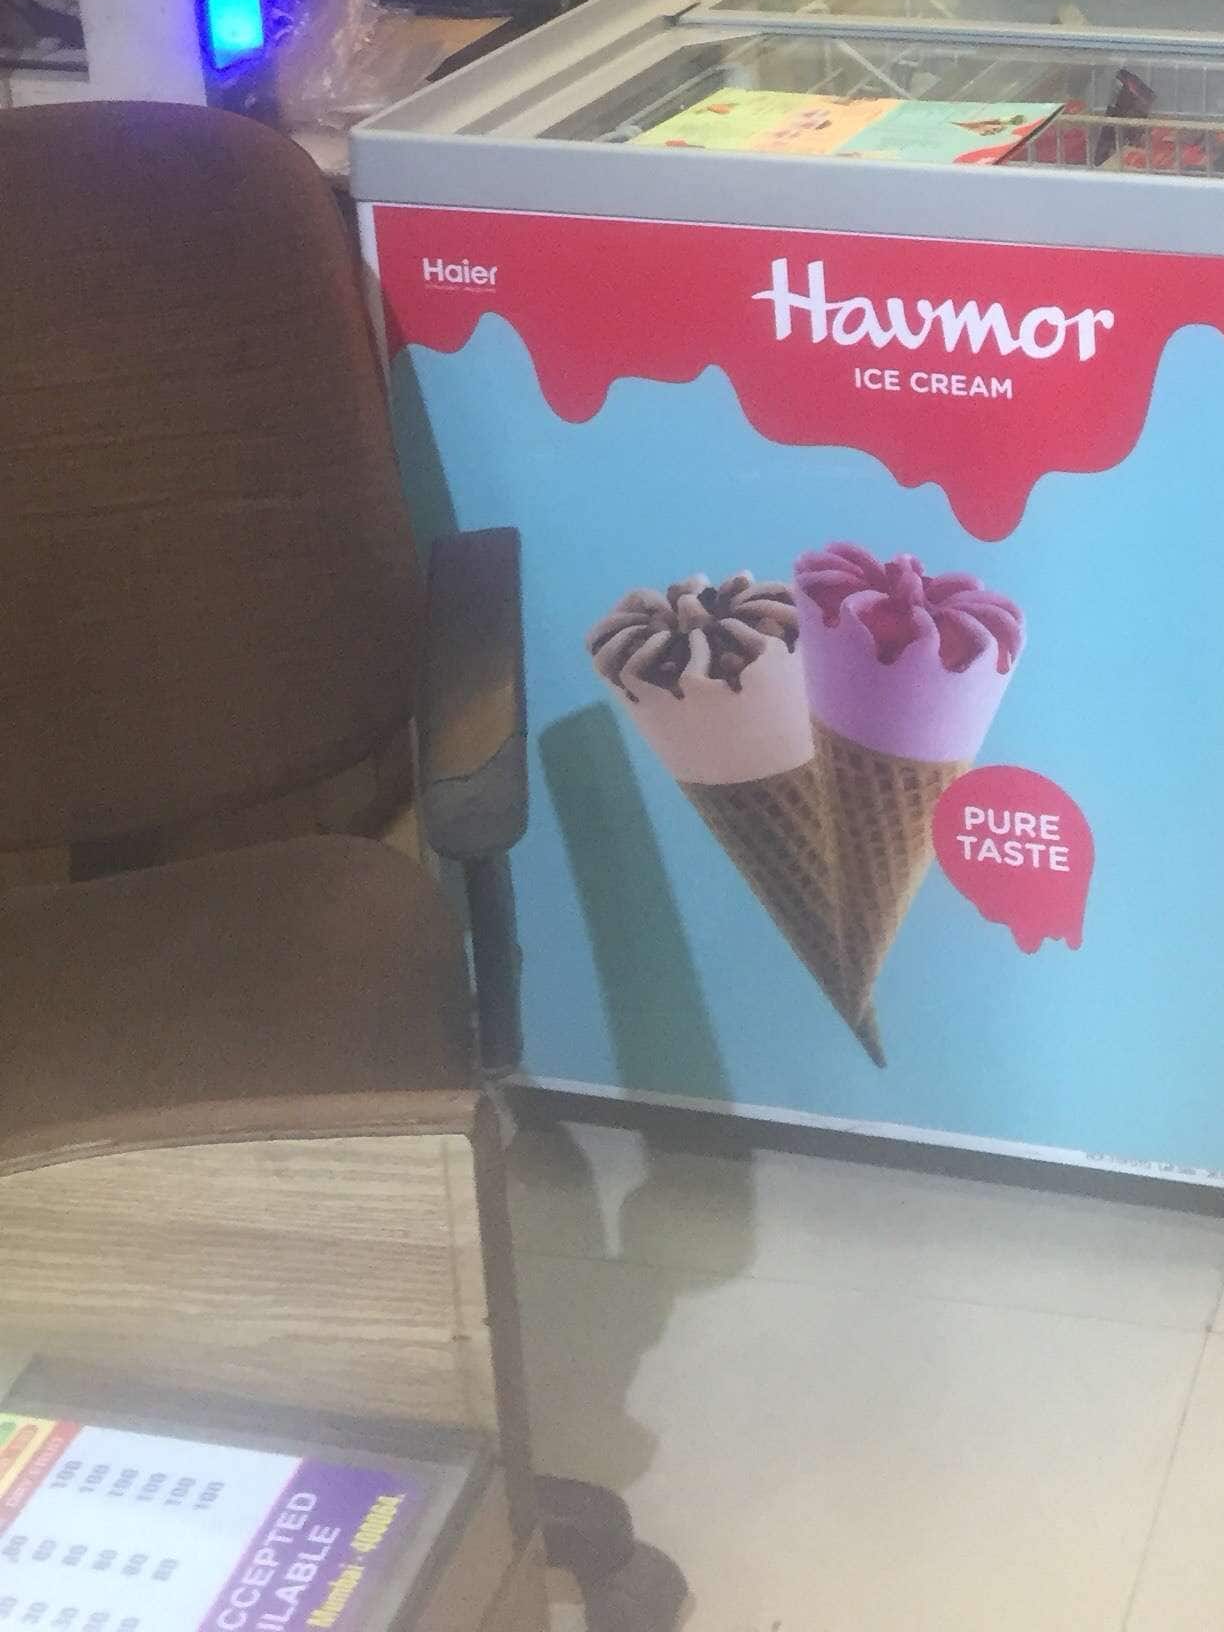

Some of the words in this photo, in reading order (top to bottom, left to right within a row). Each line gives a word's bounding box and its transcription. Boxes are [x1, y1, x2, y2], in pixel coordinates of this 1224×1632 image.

[422, 257, 498, 285] Haier
[751, 257, 1115, 362] Havmor
[854, 367, 901, 392] ICE
[910, 371, 1013, 400] CREAM
[964, 806, 1060, 841] PURE
[956, 835, 1071, 872] TASTE
[216, 1492, 318, 1631] CCEPTED
[256, 1525, 342, 1631] ILABLE
